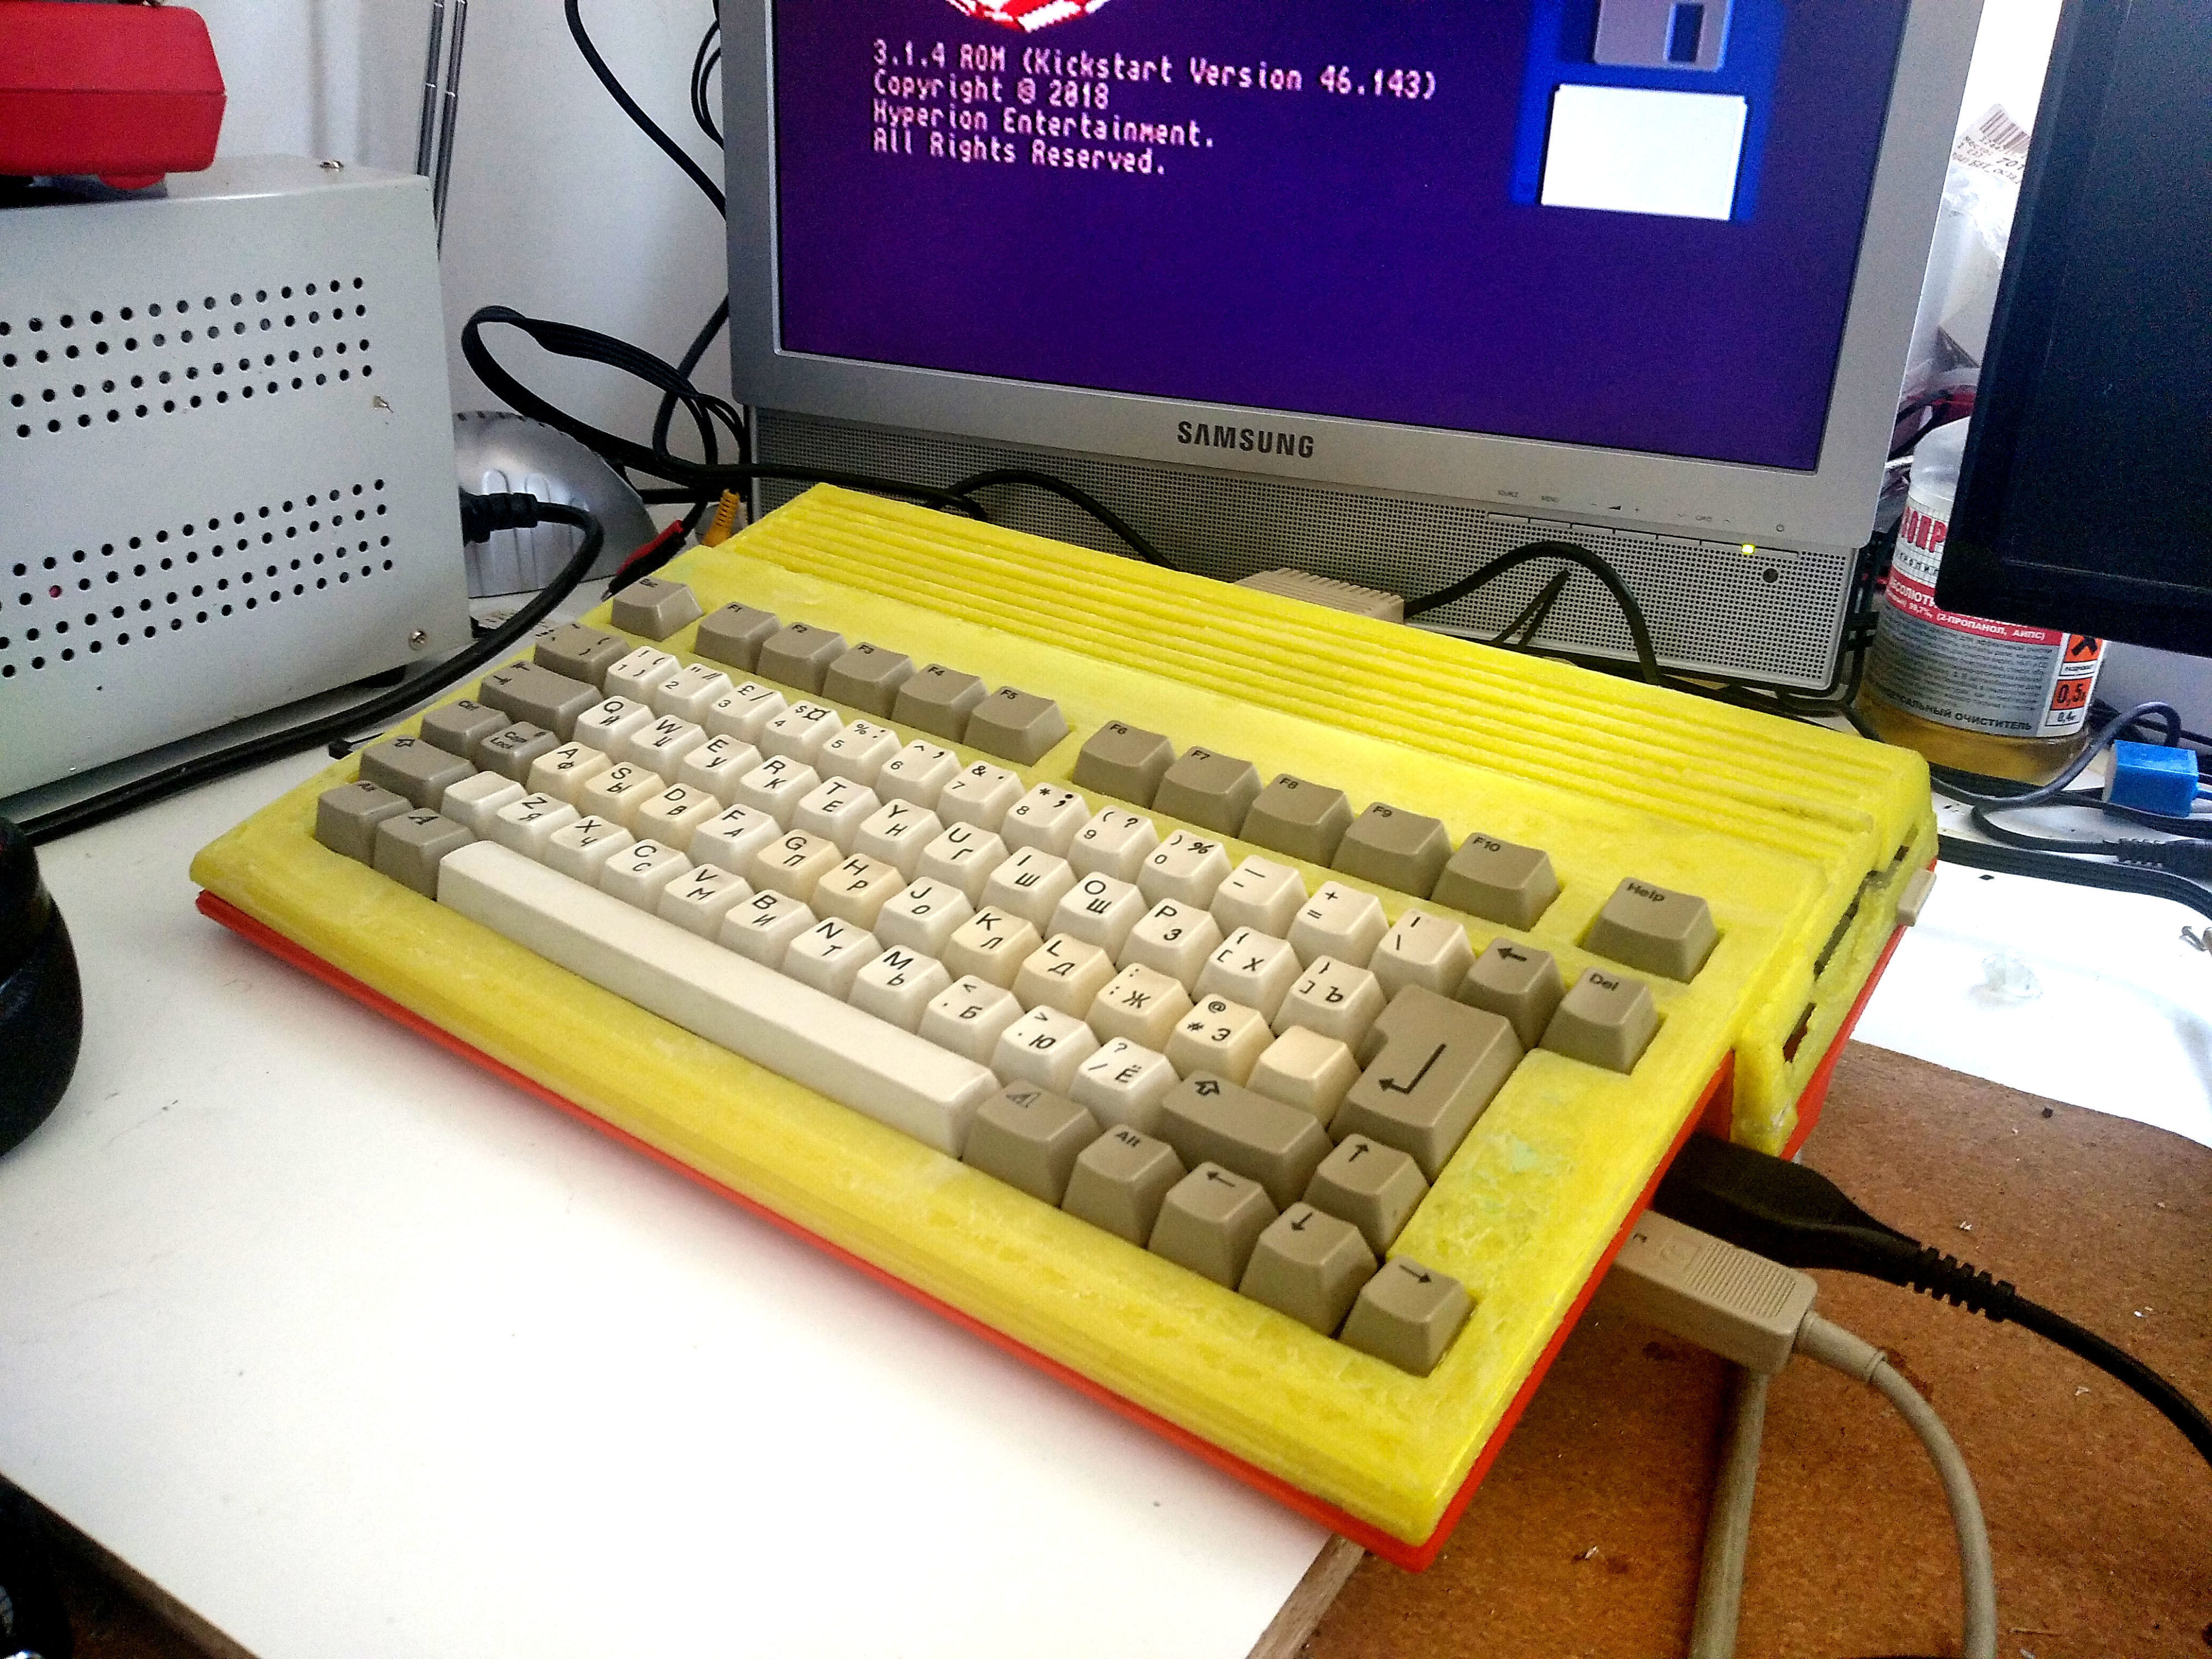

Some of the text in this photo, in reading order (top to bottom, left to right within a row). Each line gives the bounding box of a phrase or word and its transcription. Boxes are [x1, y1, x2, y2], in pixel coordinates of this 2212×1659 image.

[874, 39, 1436, 99] 3.1.4 ROM (Kickstart Version 46.143)
[873, 69, 1003, 104] Copyright
[1049, 79, 1109, 110] 2018
[873, 99, 1214, 149] Hyperion Entertainment.
[874, 127, 1165, 175] All Rights Reserved.
[1177, 421, 1314, 458] SAMSUNG
[727, 604, 742, 613] F1
[792, 624, 808, 633] F2
[857, 644, 874, 654] F3
[928, 666, 945, 676] F4
[665, 681, 679, 690] 2
[1000, 689, 1018, 699] F5
[603, 701, 624, 714] Q
[718, 699, 731, 708] 3
[656, 719, 682, 734] W
[1954, 712, 2033, 731] ОЧИСТИТЕЛЬ
[1109, 724, 1128, 735] F6
[707, 739, 729, 753] E
[831, 740, 845, 748] 5
[557, 748, 579, 759] A
[1191, 750, 1211, 760] F7
[763, 760, 786, 775] R
[890, 761, 904, 770] 6
[611, 768, 632, 780] S
[826, 782, 847, 795] T
[952, 781, 966, 789] 7
[1279, 777, 1299, 789] F8
[664, 788, 686, 801] D
[521, 797, 548, 810] Z
[1016, 805, 1030, 815] 8
[722, 809, 746, 821] F
[888, 804, 909, 818] Y
[1372, 805, 1392, 818] F9
[575, 820, 601, 833] X
[948, 827, 972, 843] U
[1084, 830, 1097, 839] 9
[785, 837, 807, 851] G
[1472, 836, 1501, 852] F10
[634, 845, 657, 857] C
[1154, 854, 1167, 865] 0
[843, 859, 869, 876] H
[695, 868, 718, 882] V
[910, 887, 932, 899] J
[1084, 880, 1107, 895] O
[1627, 883, 1665, 902] Help
[752, 894, 778, 910] B
[1154, 905, 1177, 918] P
[975, 912, 1002, 931] K
[816, 922, 844, 939] N
[1047, 940, 1062, 957] L
[883, 951, 914, 970] M
[1589, 973, 1620, 991] Del
